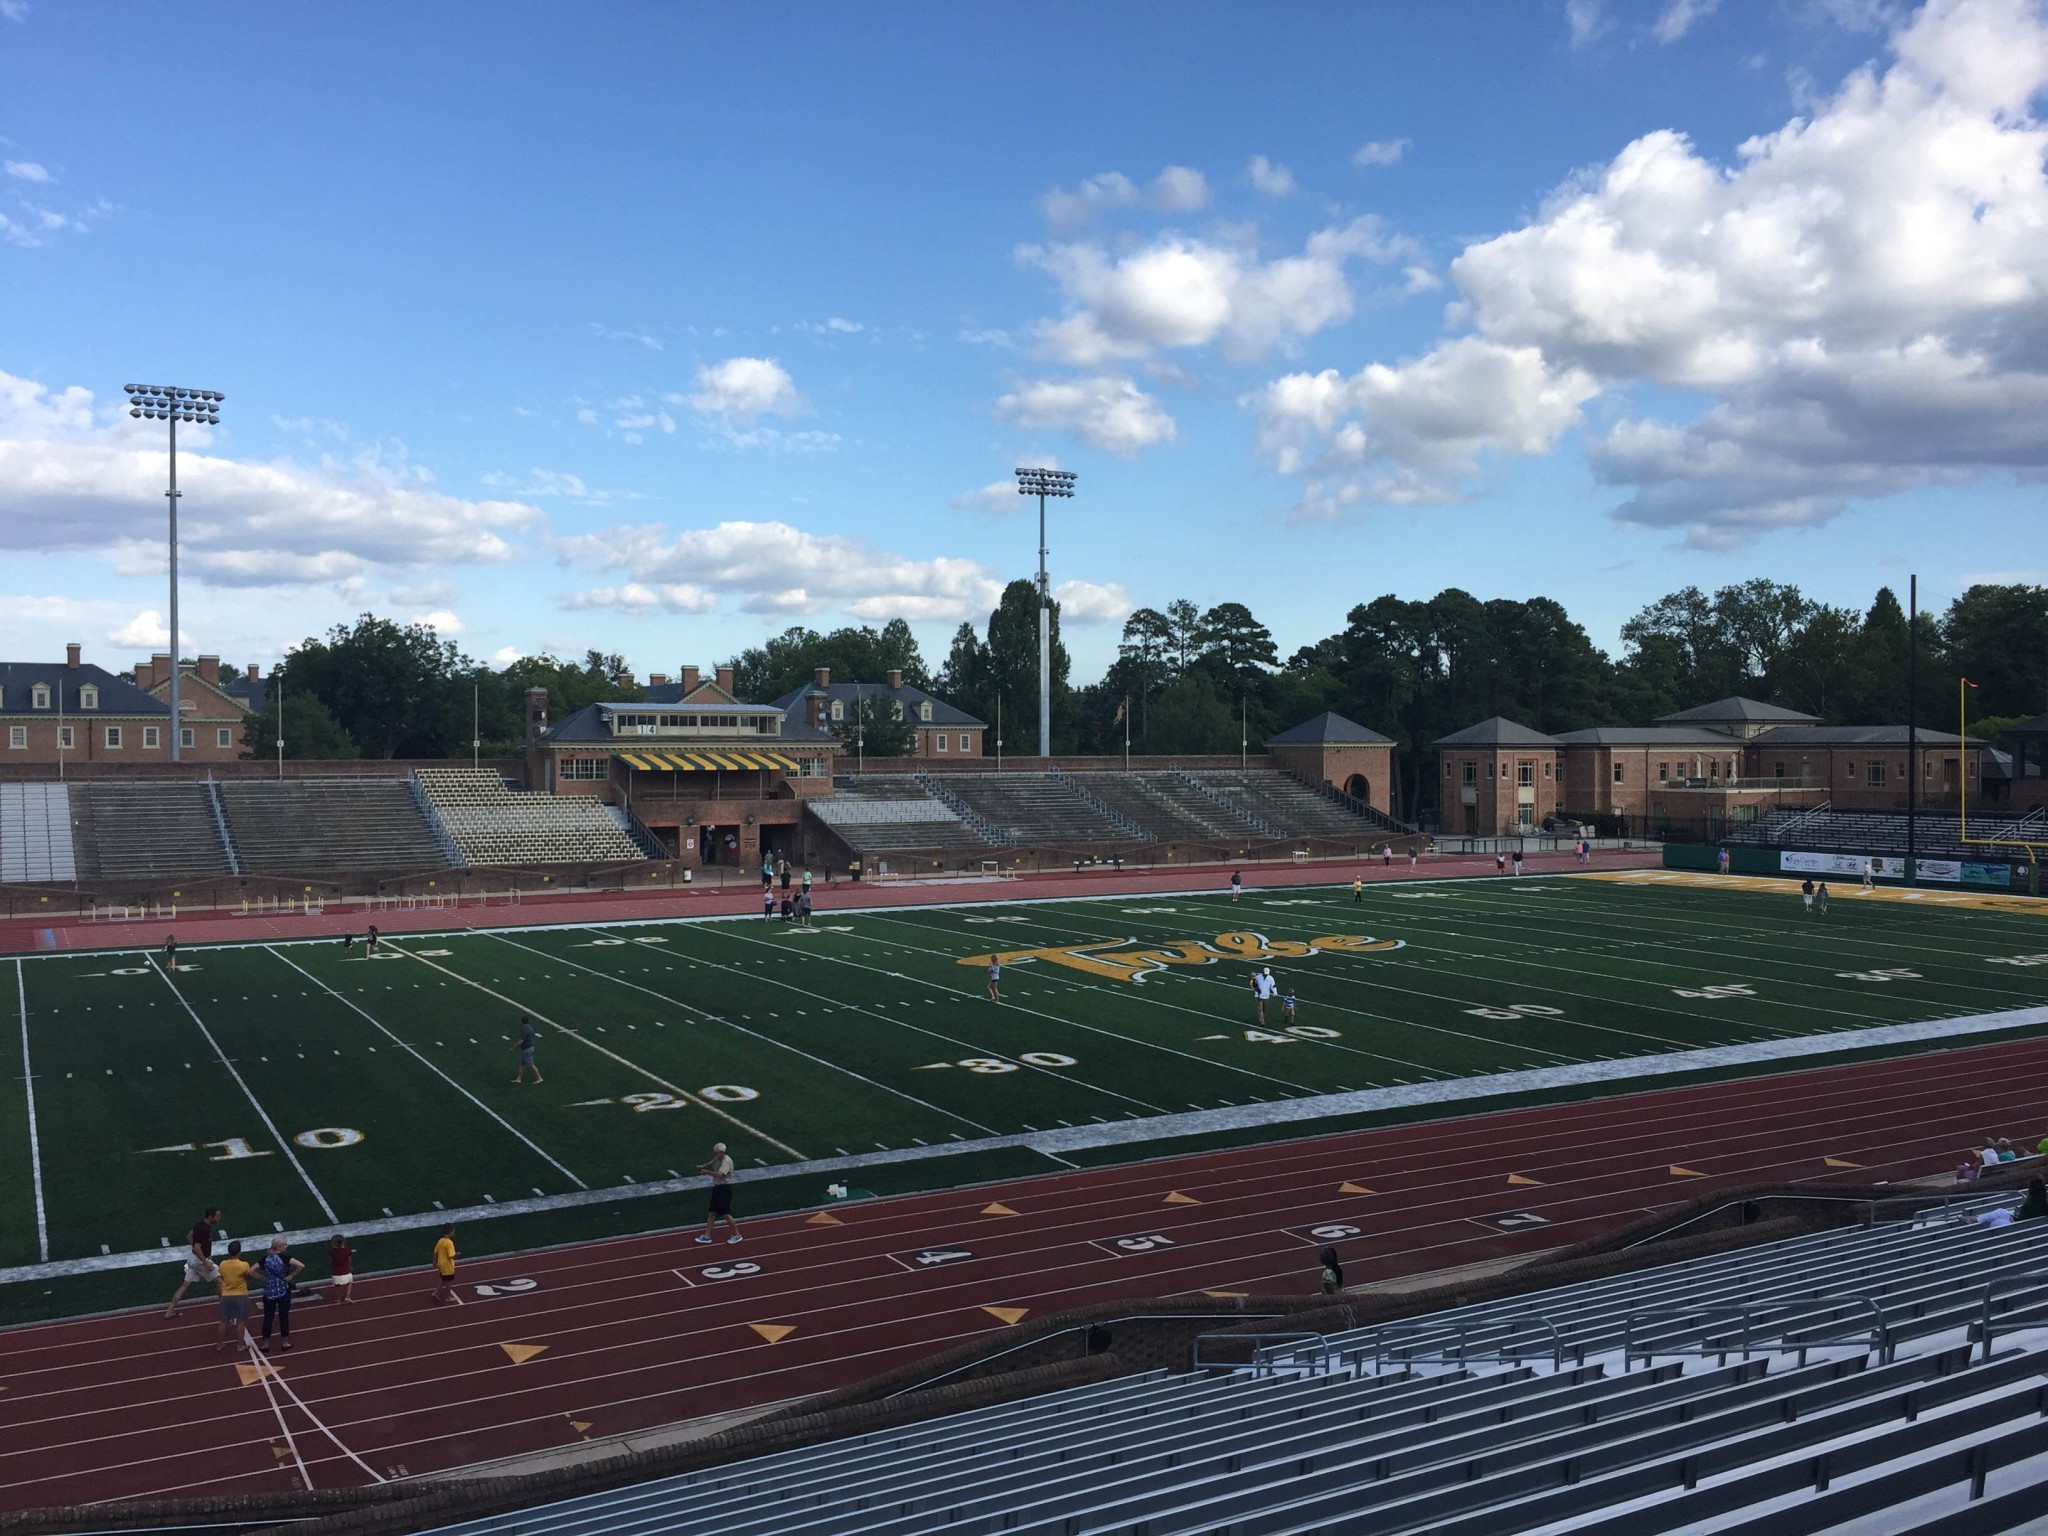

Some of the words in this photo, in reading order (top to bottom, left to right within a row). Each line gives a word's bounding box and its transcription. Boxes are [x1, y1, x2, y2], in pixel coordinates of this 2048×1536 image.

[1461, 1003, 1566, 1020] 50
[1243, 1025, 1343, 1044] 40
[956, 1051, 1079, 1074] 30
[620, 1084, 761, 1113] 20
[203, 1127, 365, 1161] 10
[1497, 1213, 1550, 1226] 7
[1311, 1224, 1362, 1238] 6
[1117, 1234, 1176, 1250] 5
[916, 1250, 973, 1265] 4
[701, 1262, 761, 1279] 3
[473, 1278, 538, 1296] 2
